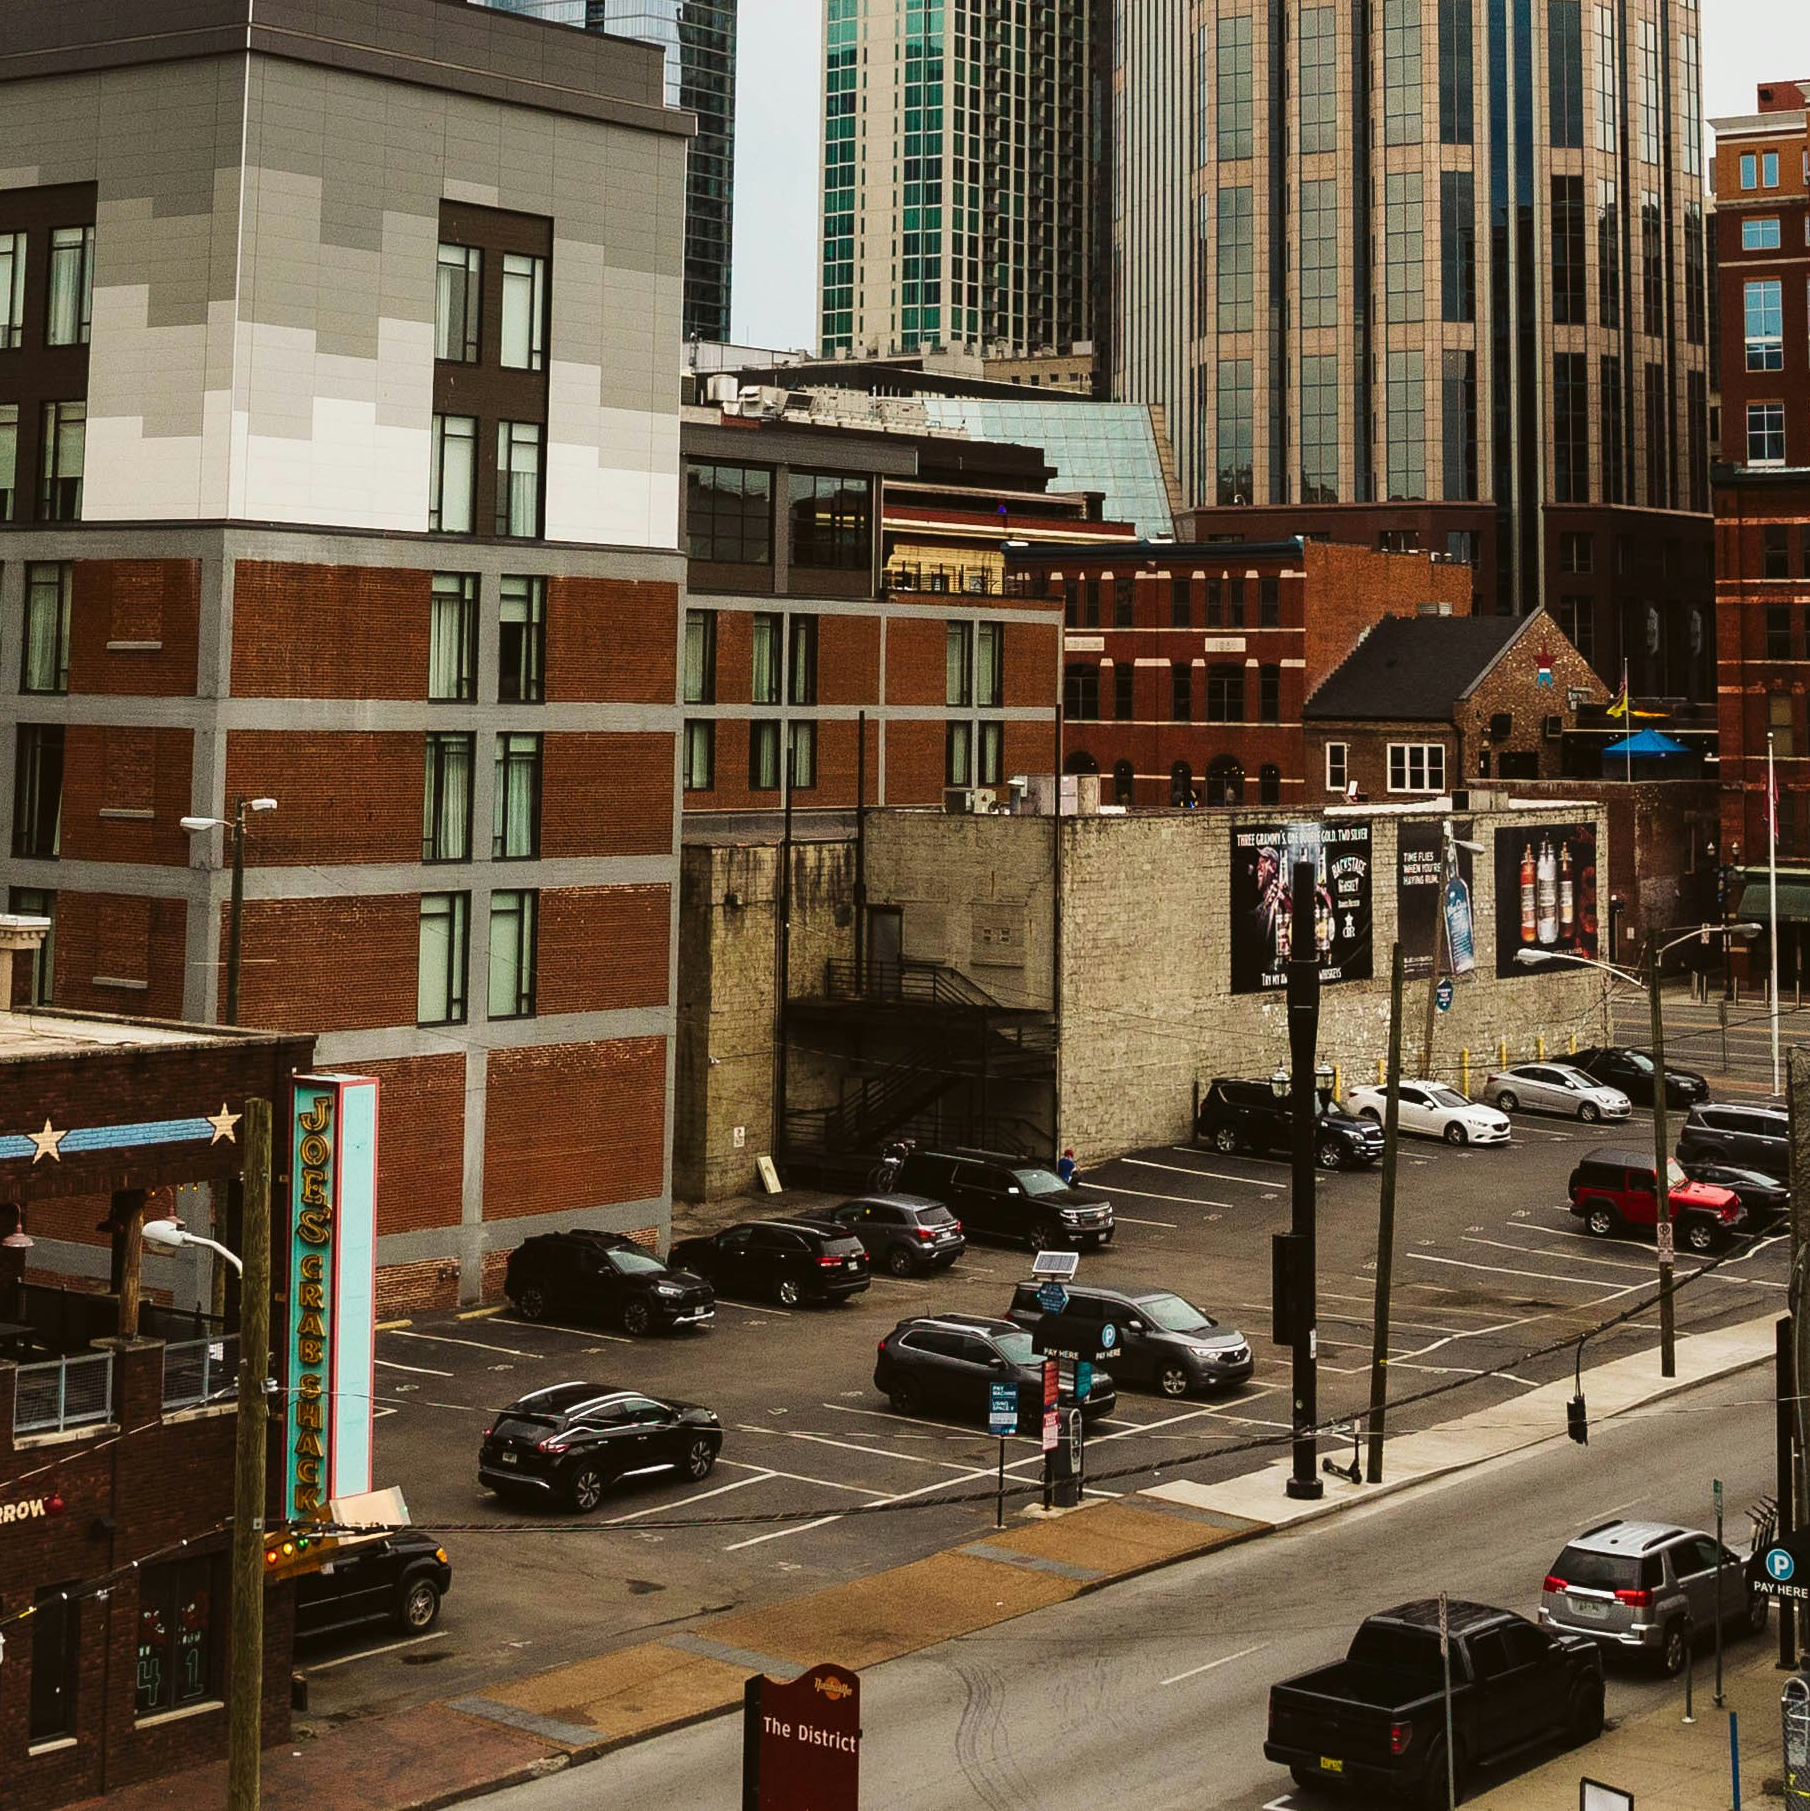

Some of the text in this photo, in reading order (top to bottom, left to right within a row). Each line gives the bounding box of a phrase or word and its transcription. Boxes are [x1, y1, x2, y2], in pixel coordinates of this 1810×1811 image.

[1237, 833, 1255, 846] THREE
[1338, 829, 1350, 841] TWO
[1350, 828, 1368, 840] SILVER
[1403, 851, 1434, 862] TIME FLIES
[1331, 857, 1367, 879] BACKSTAGE
[1403, 864, 1421, 873] WHEN
[294, 1095, 334, 1513] JOE'S CRAB SHACK
[1043, 1347, 1079, 1360] PAY HERE
[1095, 1347, 1121, 1361] PAY HERE
[1774, 1555, 1790, 1575] P
[1753, 1581, 1809, 1598] PAY HERE
[763, 1716, 857, 1753] The District
